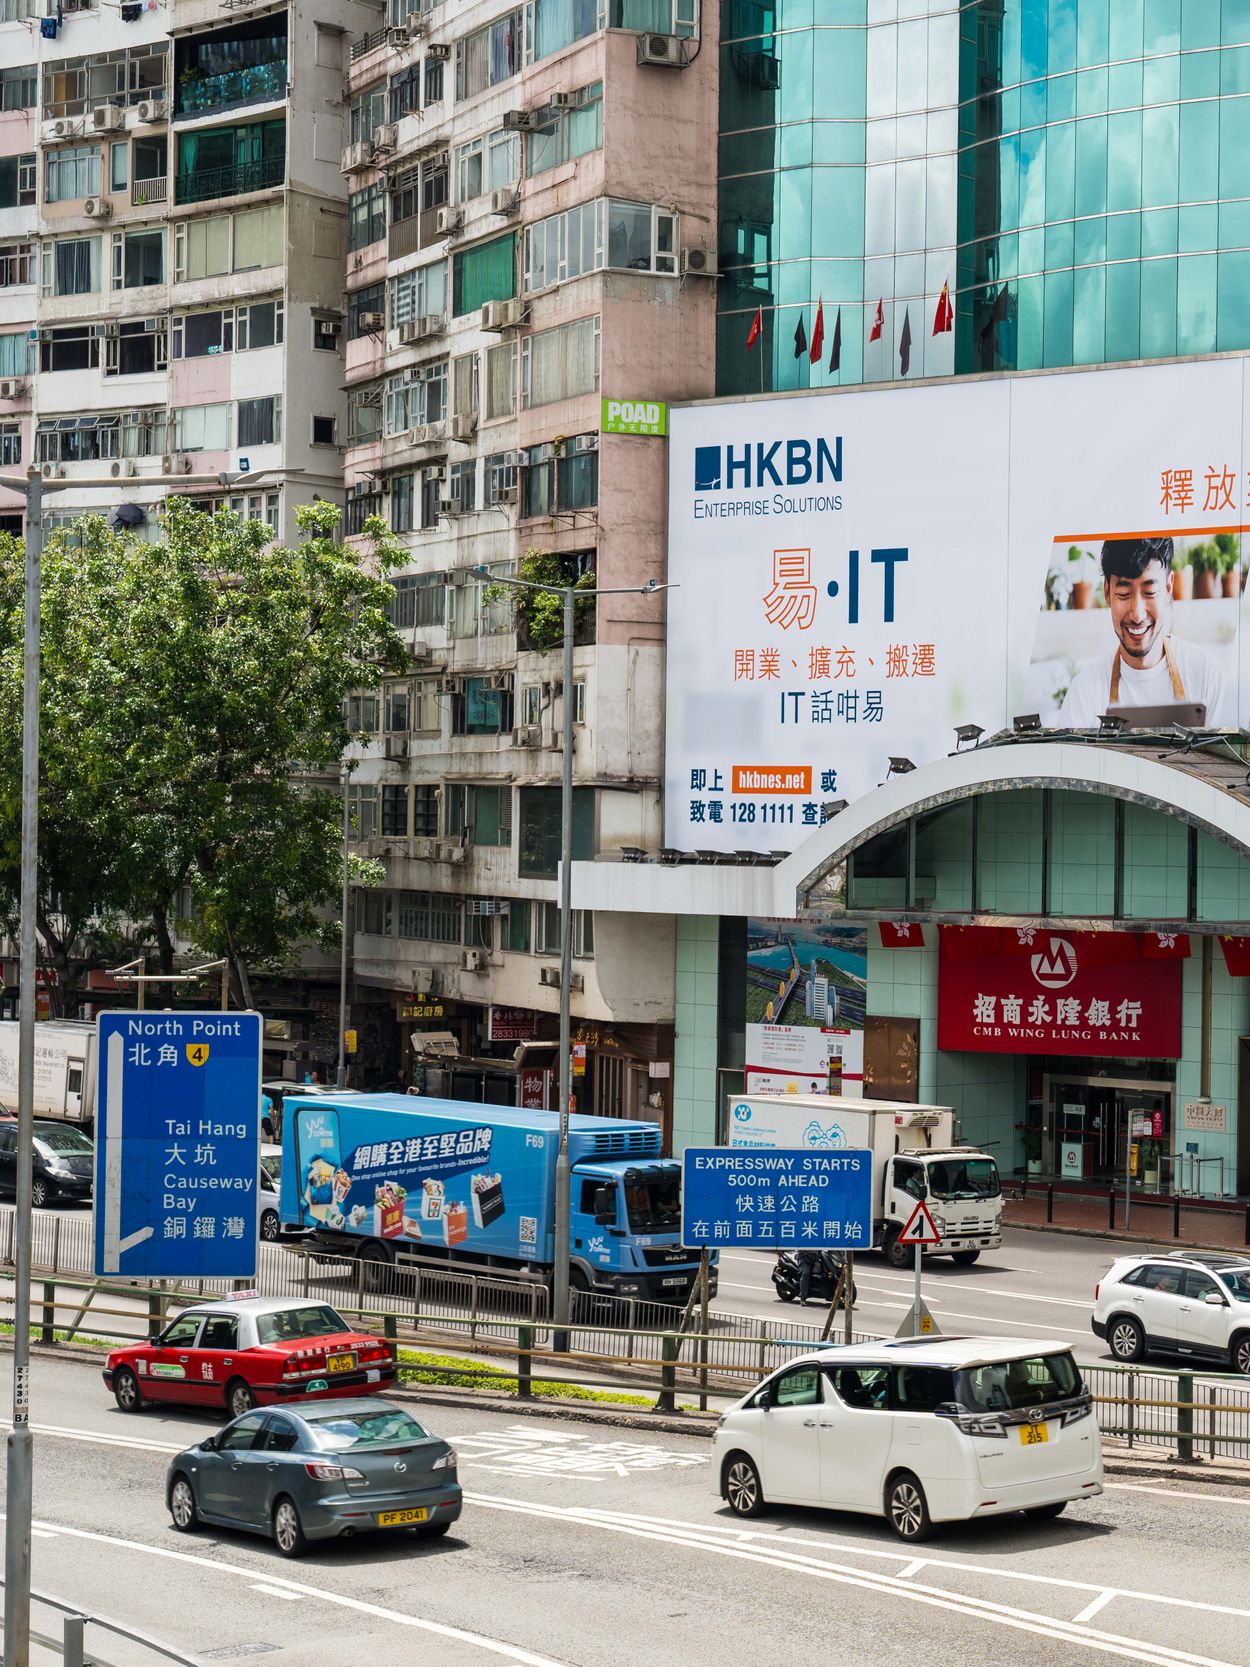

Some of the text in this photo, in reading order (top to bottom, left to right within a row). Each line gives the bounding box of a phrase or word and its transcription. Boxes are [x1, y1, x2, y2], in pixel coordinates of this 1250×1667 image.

[608, 402, 660, 424] POAD
[726, 436, 844, 490] HKBN
[733, 642, 937, 682] 開業、擴充、搬遷
[690, 767, 838, 793] 即上 hkbnes.net 或
[690, 800, 724, 824] 致電
[730, 803, 756, 824] 128
[760, 802, 795, 823] 1111
[972, 992, 1143, 1028] 招商永隆銀行
[128, 1019, 241, 1037] North Point
[973, 1026, 1142, 1041] CMB WING LUNG BANK
[128, 1042, 203, 1067] 北角 4
[164, 1119, 247, 1139] Tai Hang
[352, 1127, 493, 1170] 網購全港至堅品牌
[525, 1134, 544, 1149] F69
[164, 1142, 217, 1166] 大坑
[695, 1157, 861, 1171] EXPRESSWAY STARTS
[163, 1173, 253, 1192] Causeway
[727, 1174, 829, 1187] 500m AHEAD
[163, 1193, 197, 1212] Bay
[735, 1194, 820, 1213] 快速公路
[163, 1216, 245, 1239] 銅鑼灣
[691, 1219, 863, 1240] 在前面五百米開始
[635, 1237, 651, 1246] F69
[201, 1371, 214, 1380] TAXI
[1027, 1424, 1039, 1435] JT
[1027, 1433, 1043, 1444] 215
[383, 1510, 424, 1524] PF 2041
